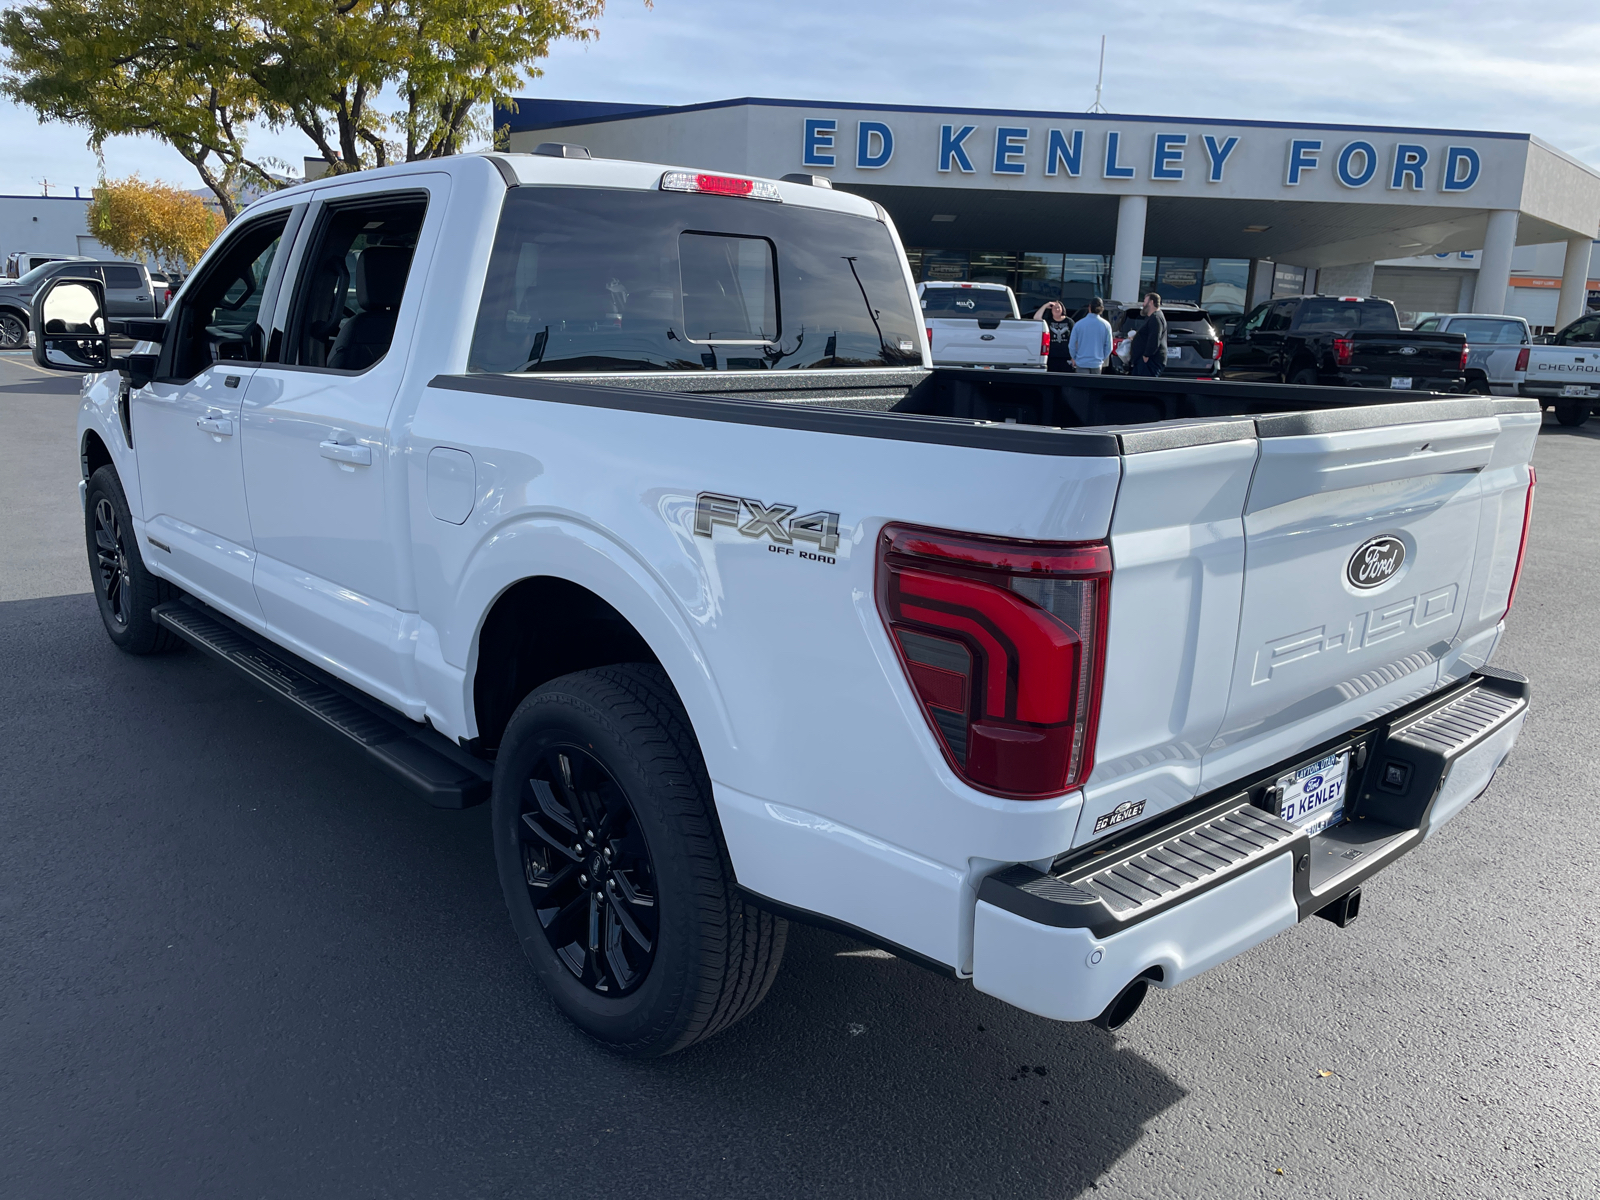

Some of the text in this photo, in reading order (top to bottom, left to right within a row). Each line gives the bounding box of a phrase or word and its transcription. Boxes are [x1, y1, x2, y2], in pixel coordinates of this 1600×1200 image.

[802, 118, 1481, 193] ED KENLEY FORD
[693, 490, 841, 554] FX4
[768, 544, 836, 565] OFF ROAD
[1358, 544, 1398, 581] Ford
[1250, 582, 1460, 687] F-150
[1280, 779, 1344, 821] ED KENLEY
[1305, 777, 1322, 793] Ford
[1095, 803, 1145, 831] ED KENLEY
